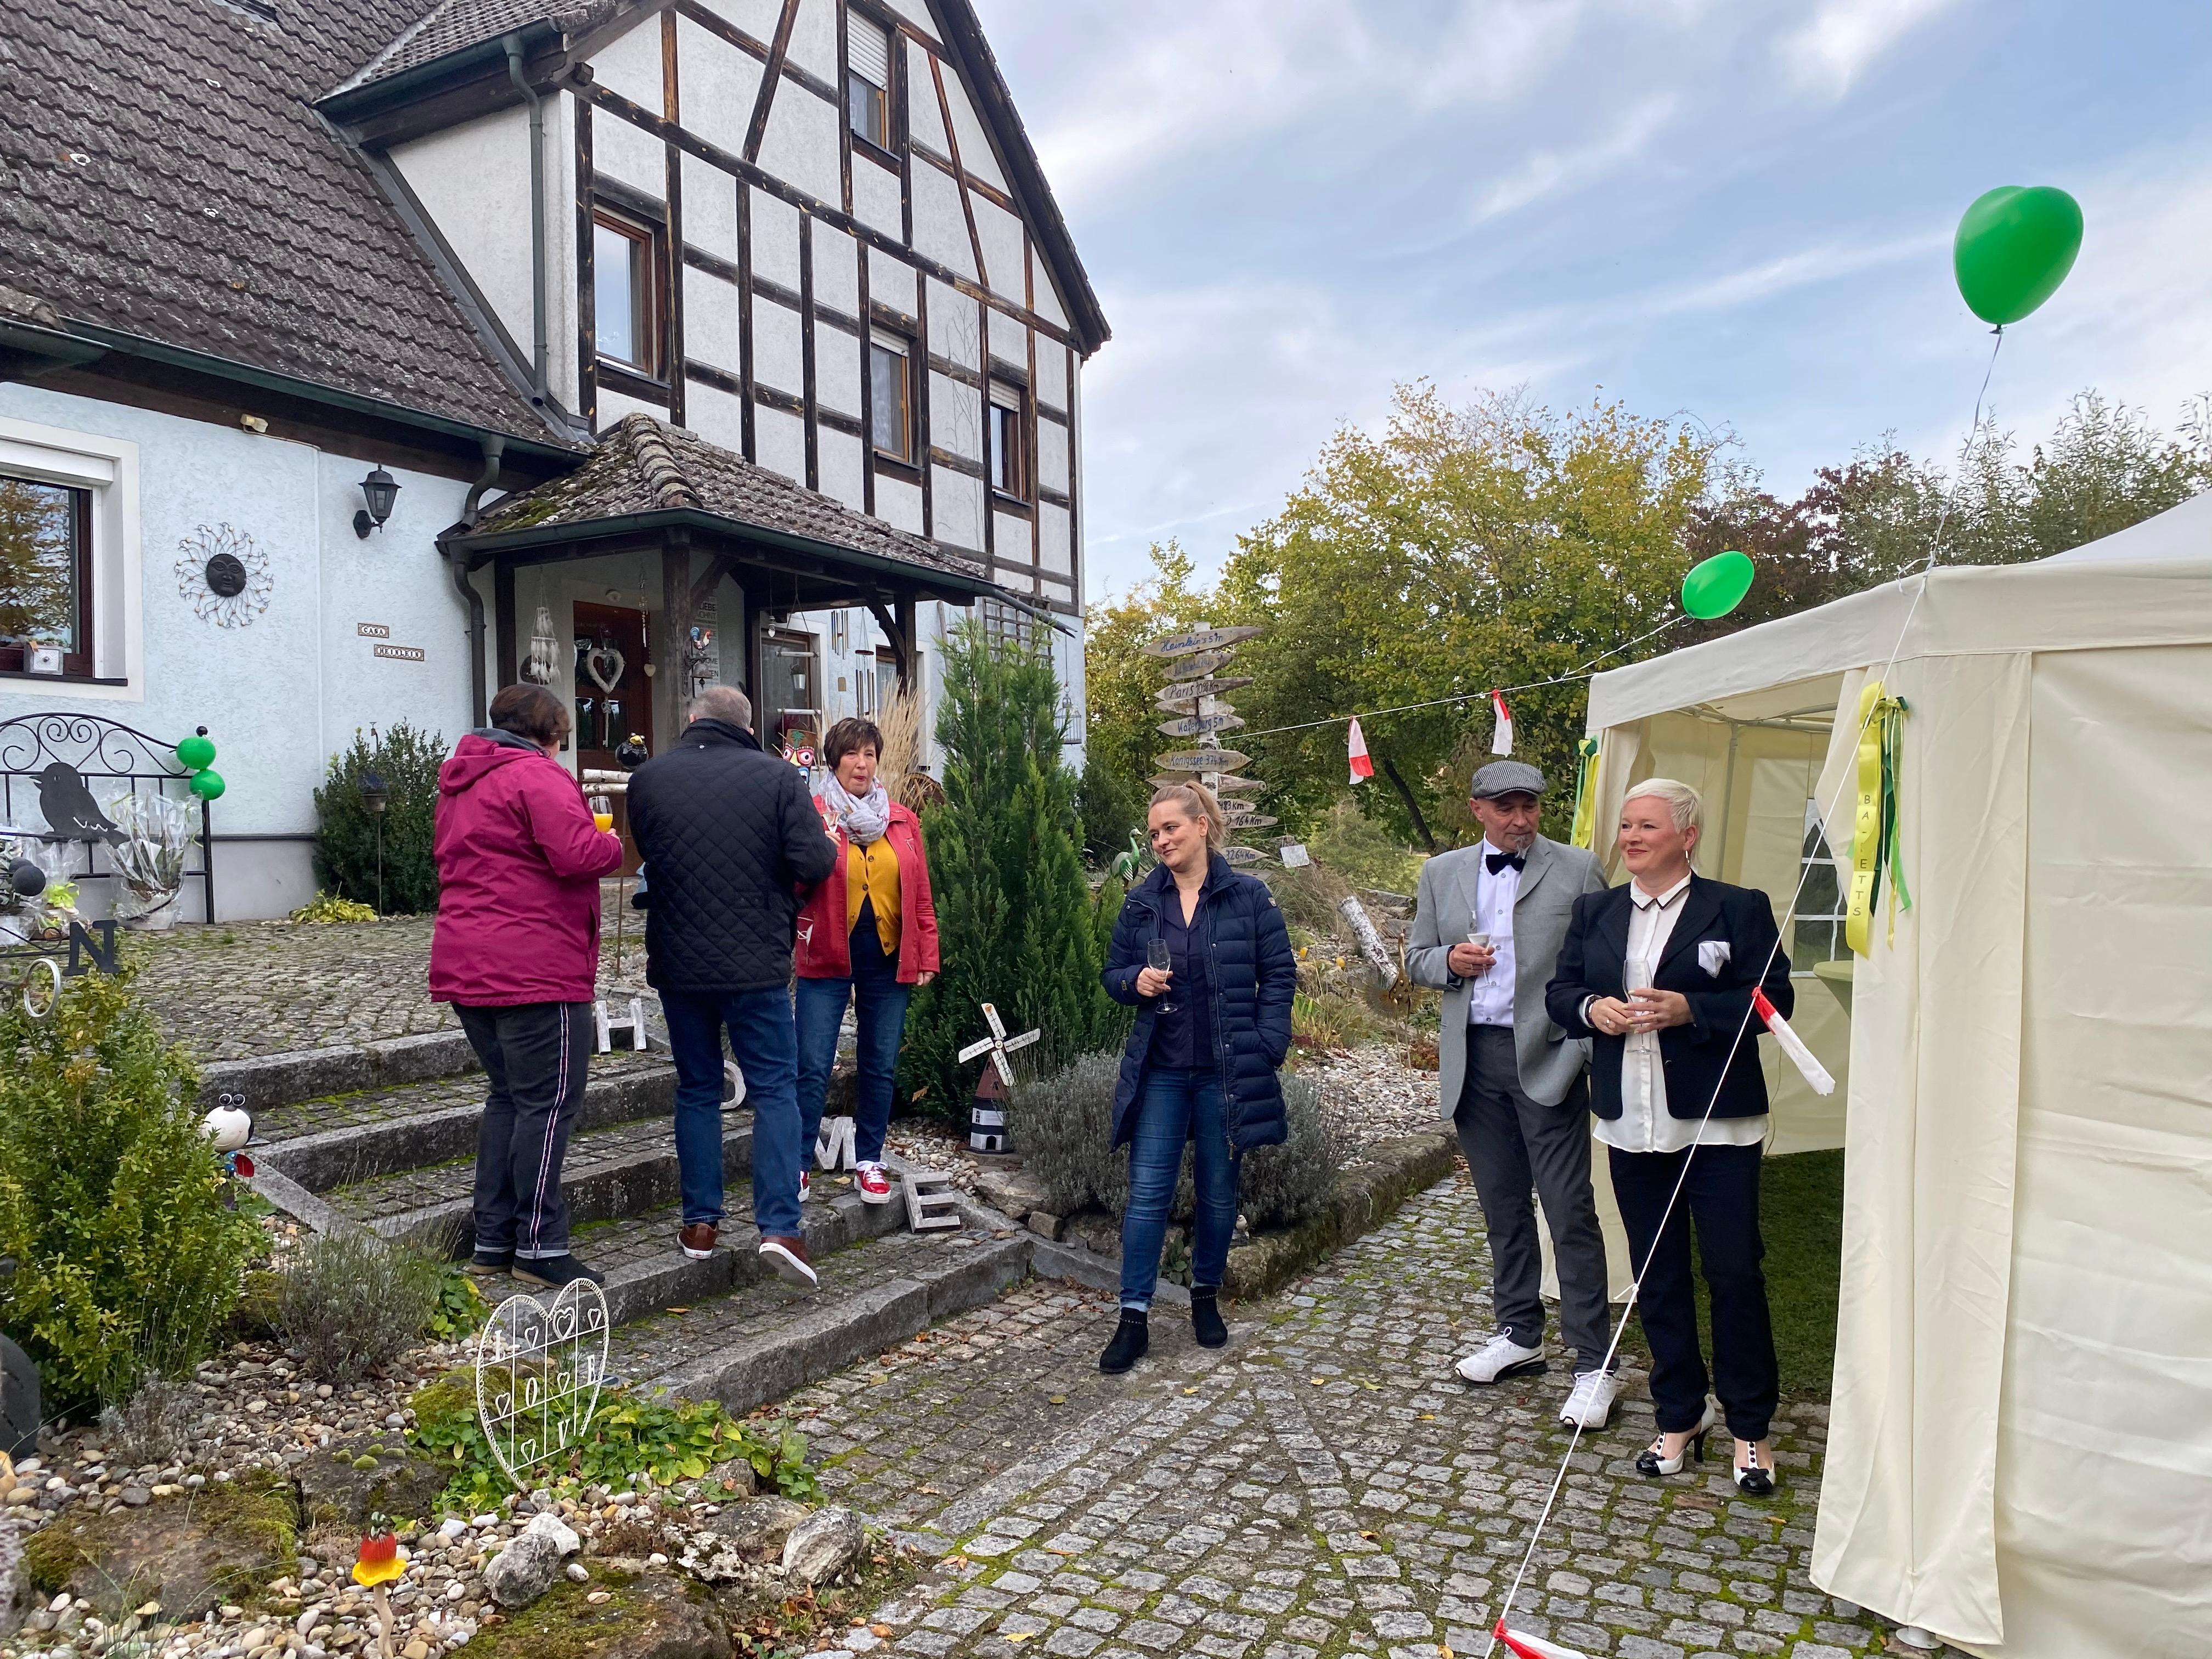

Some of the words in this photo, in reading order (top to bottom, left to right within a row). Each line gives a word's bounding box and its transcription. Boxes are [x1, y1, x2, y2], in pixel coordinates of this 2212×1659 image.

[364, 627, 383, 635] CASA
[380, 647, 419, 658] HEINLEIN
[62, 919, 121, 977] N
